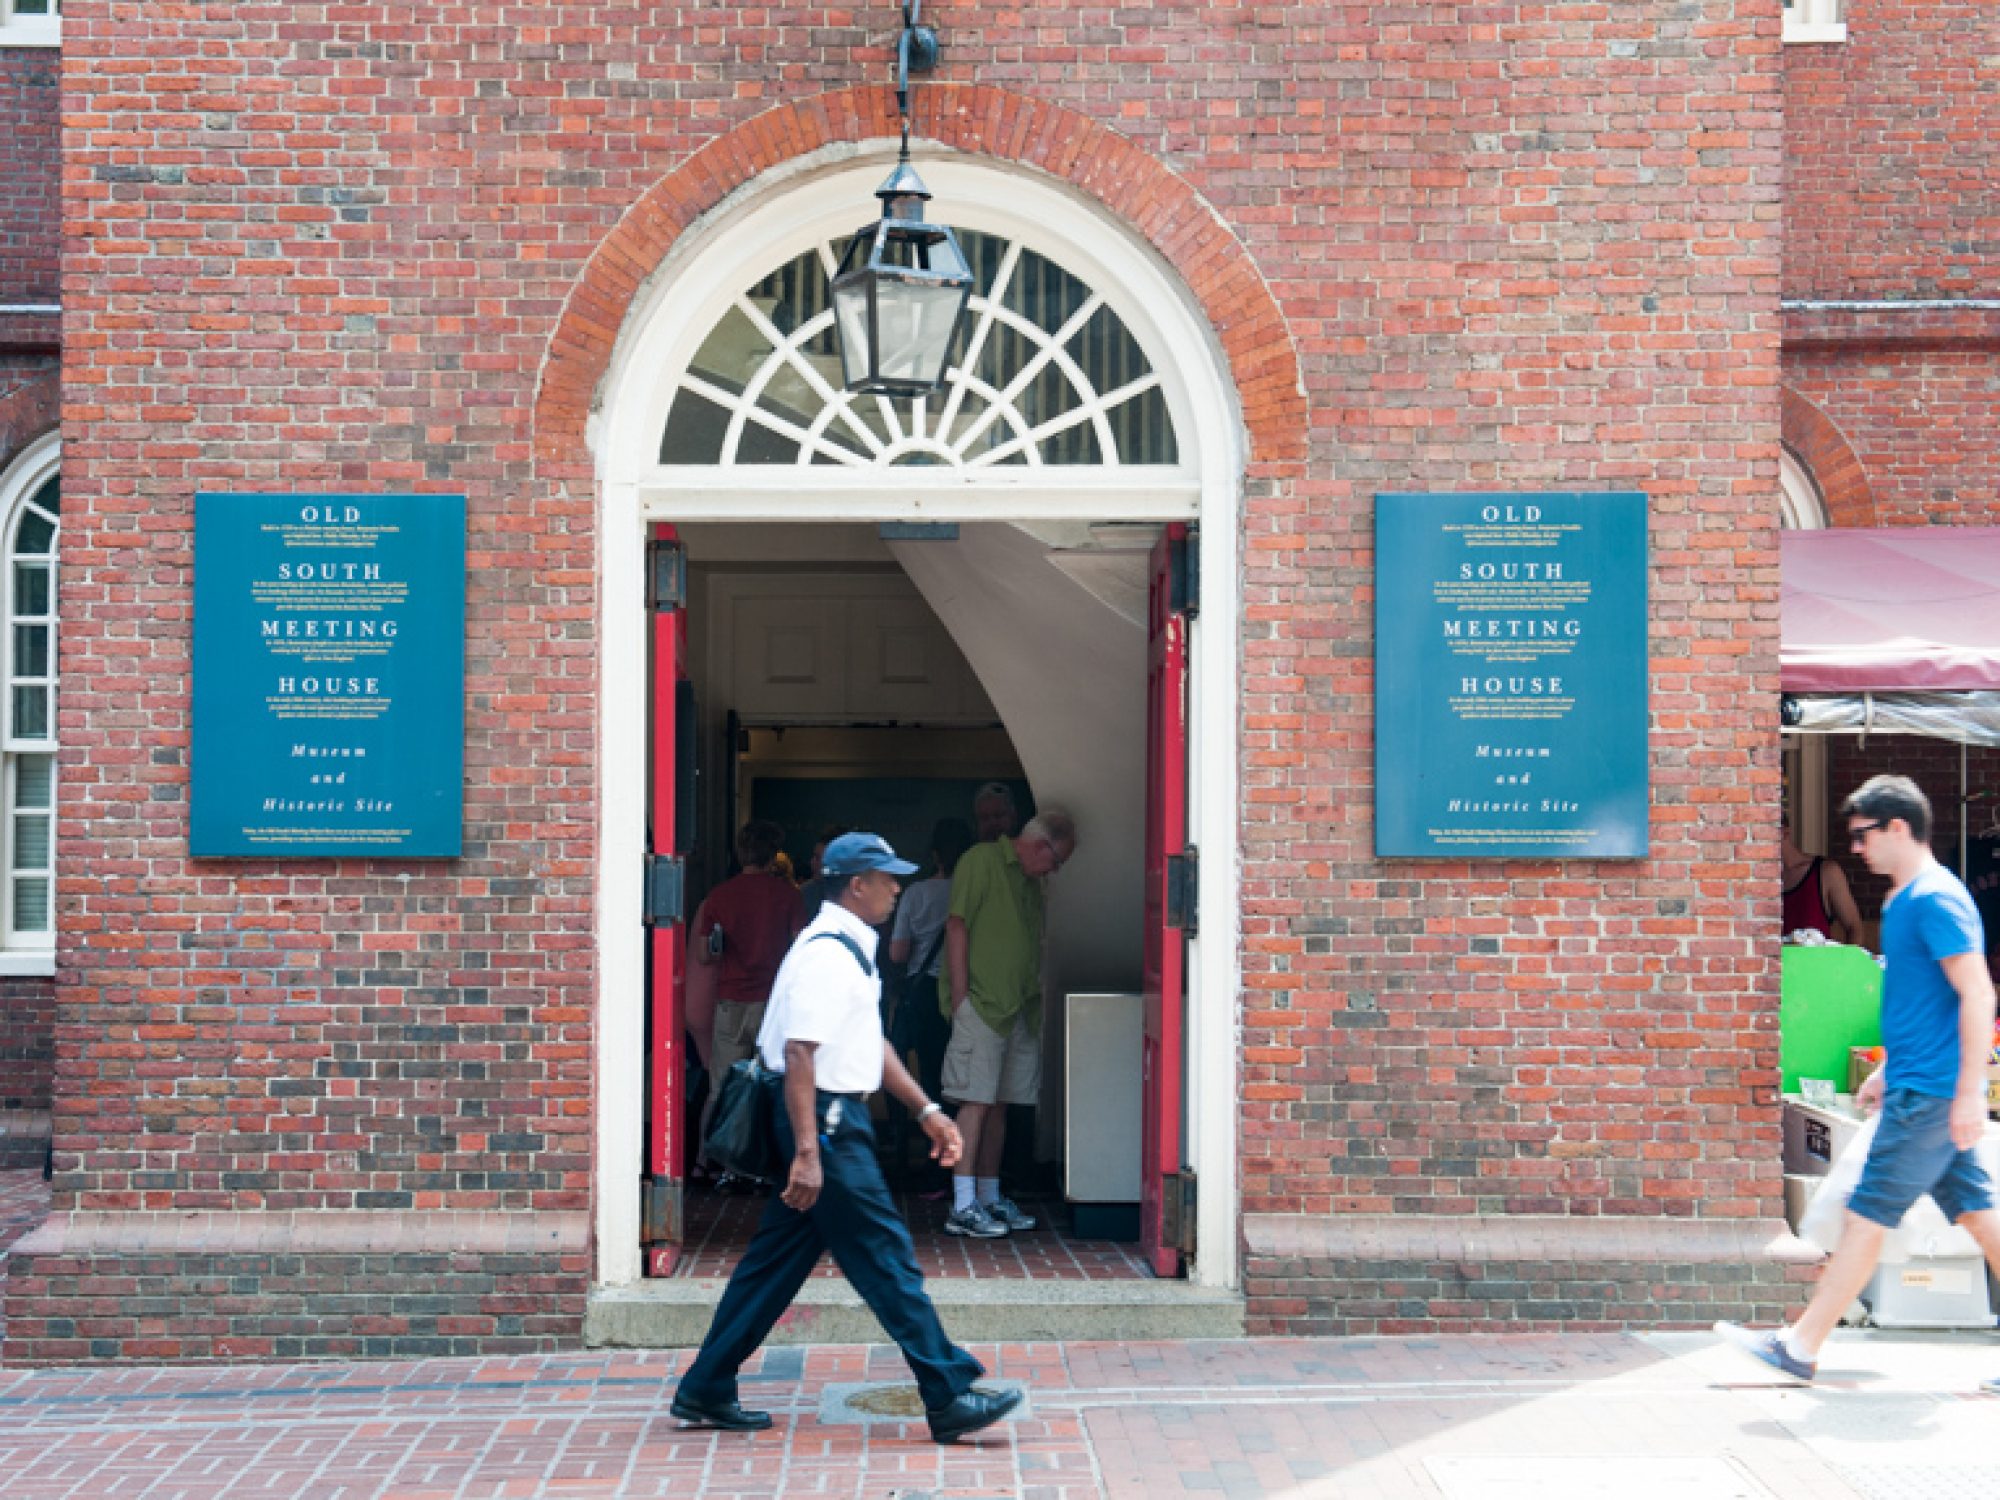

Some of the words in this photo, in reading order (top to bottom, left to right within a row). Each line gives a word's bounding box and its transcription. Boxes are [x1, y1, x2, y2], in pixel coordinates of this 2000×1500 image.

[301, 506, 361, 523] OLD
[1482, 506, 1542, 523] OLD
[279, 564, 379, 580] SOUTH
[1461, 563, 1562, 580] SOUTH
[263, 621, 397, 637] MEETING
[1445, 621, 1581, 637] MEETING
[279, 678, 379, 695] HOUSE
[1463, 678, 1563, 694] HOUSE
[292, 743, 366, 758] Museum
[1476, 745, 1550, 758] Museum
[310, 771, 346, 784] and
[1495, 772, 1532, 784] and
